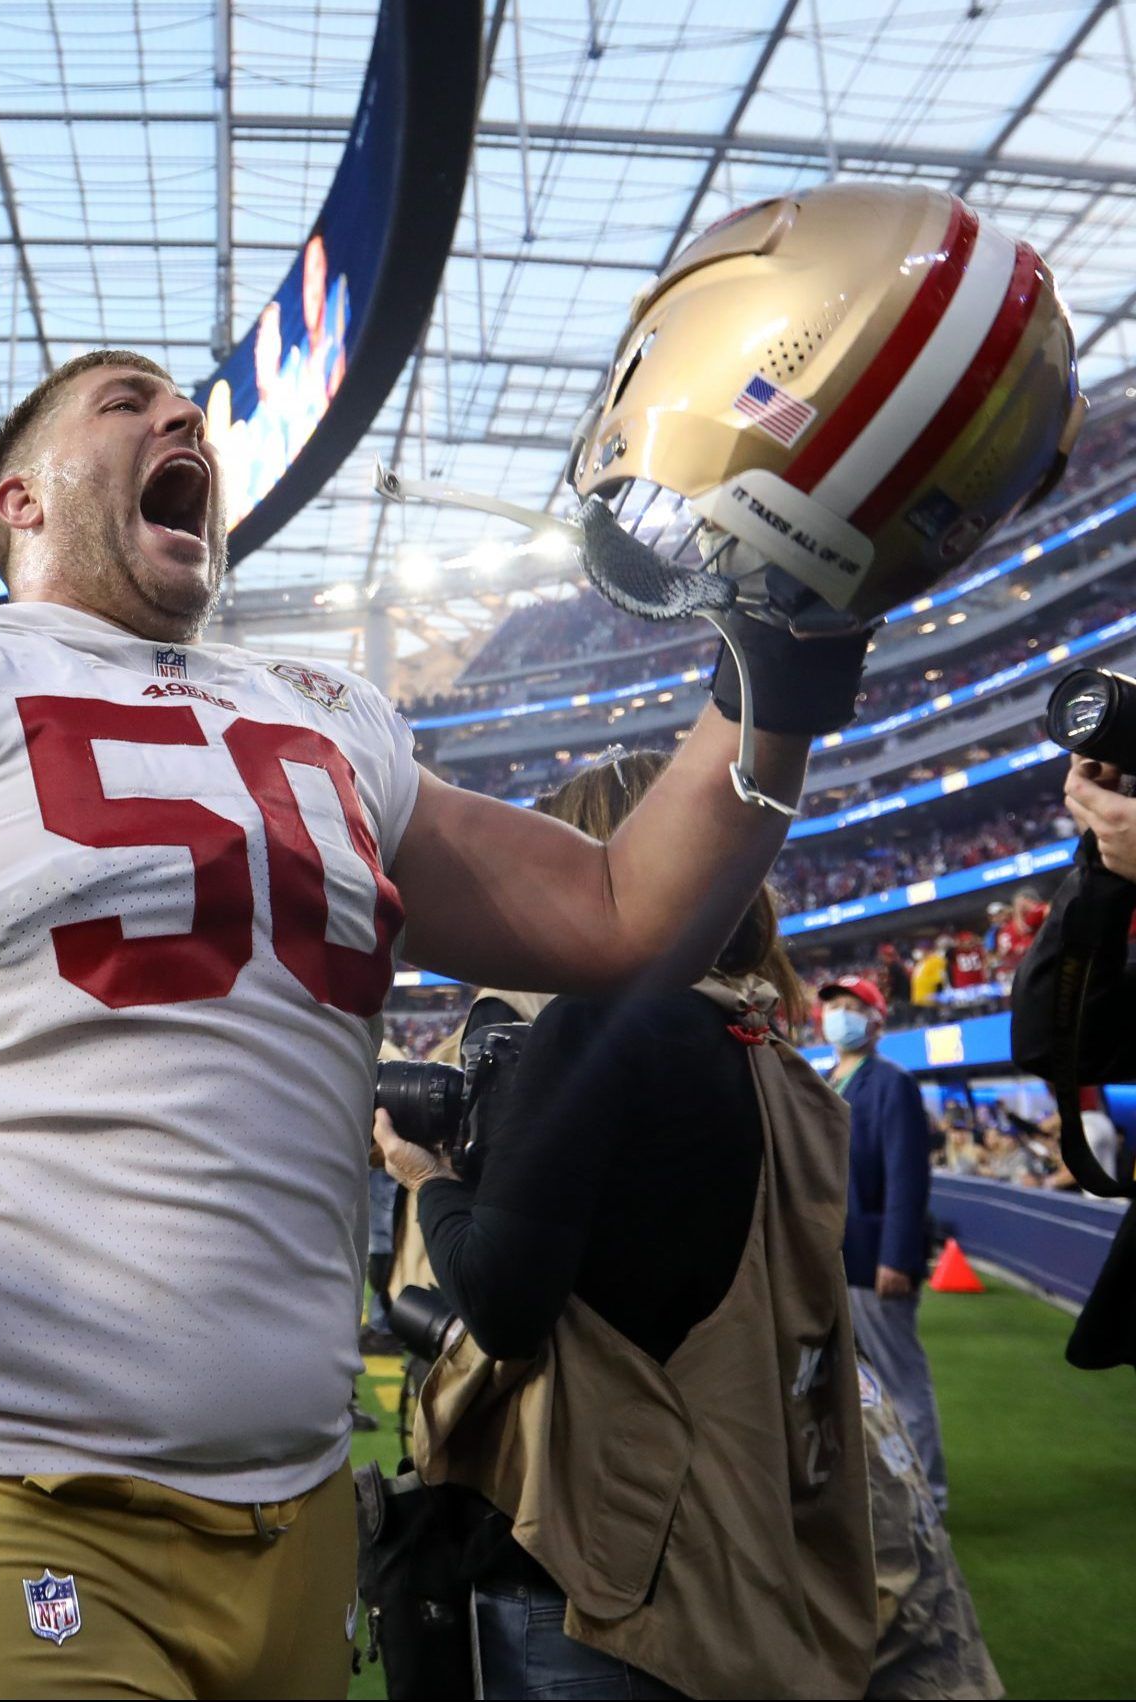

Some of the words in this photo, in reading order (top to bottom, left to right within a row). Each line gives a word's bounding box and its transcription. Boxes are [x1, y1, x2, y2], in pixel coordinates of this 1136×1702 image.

[732, 485, 749, 502] IT
[748, 498, 792, 535] TAKES
[791, 530, 817, 554] ALL
[819, 547, 841, 563] OF
[142, 682, 240, 712] 49ERS
[15, 695, 405, 1018] 50
[37, 1600, 74, 1630] NFL
